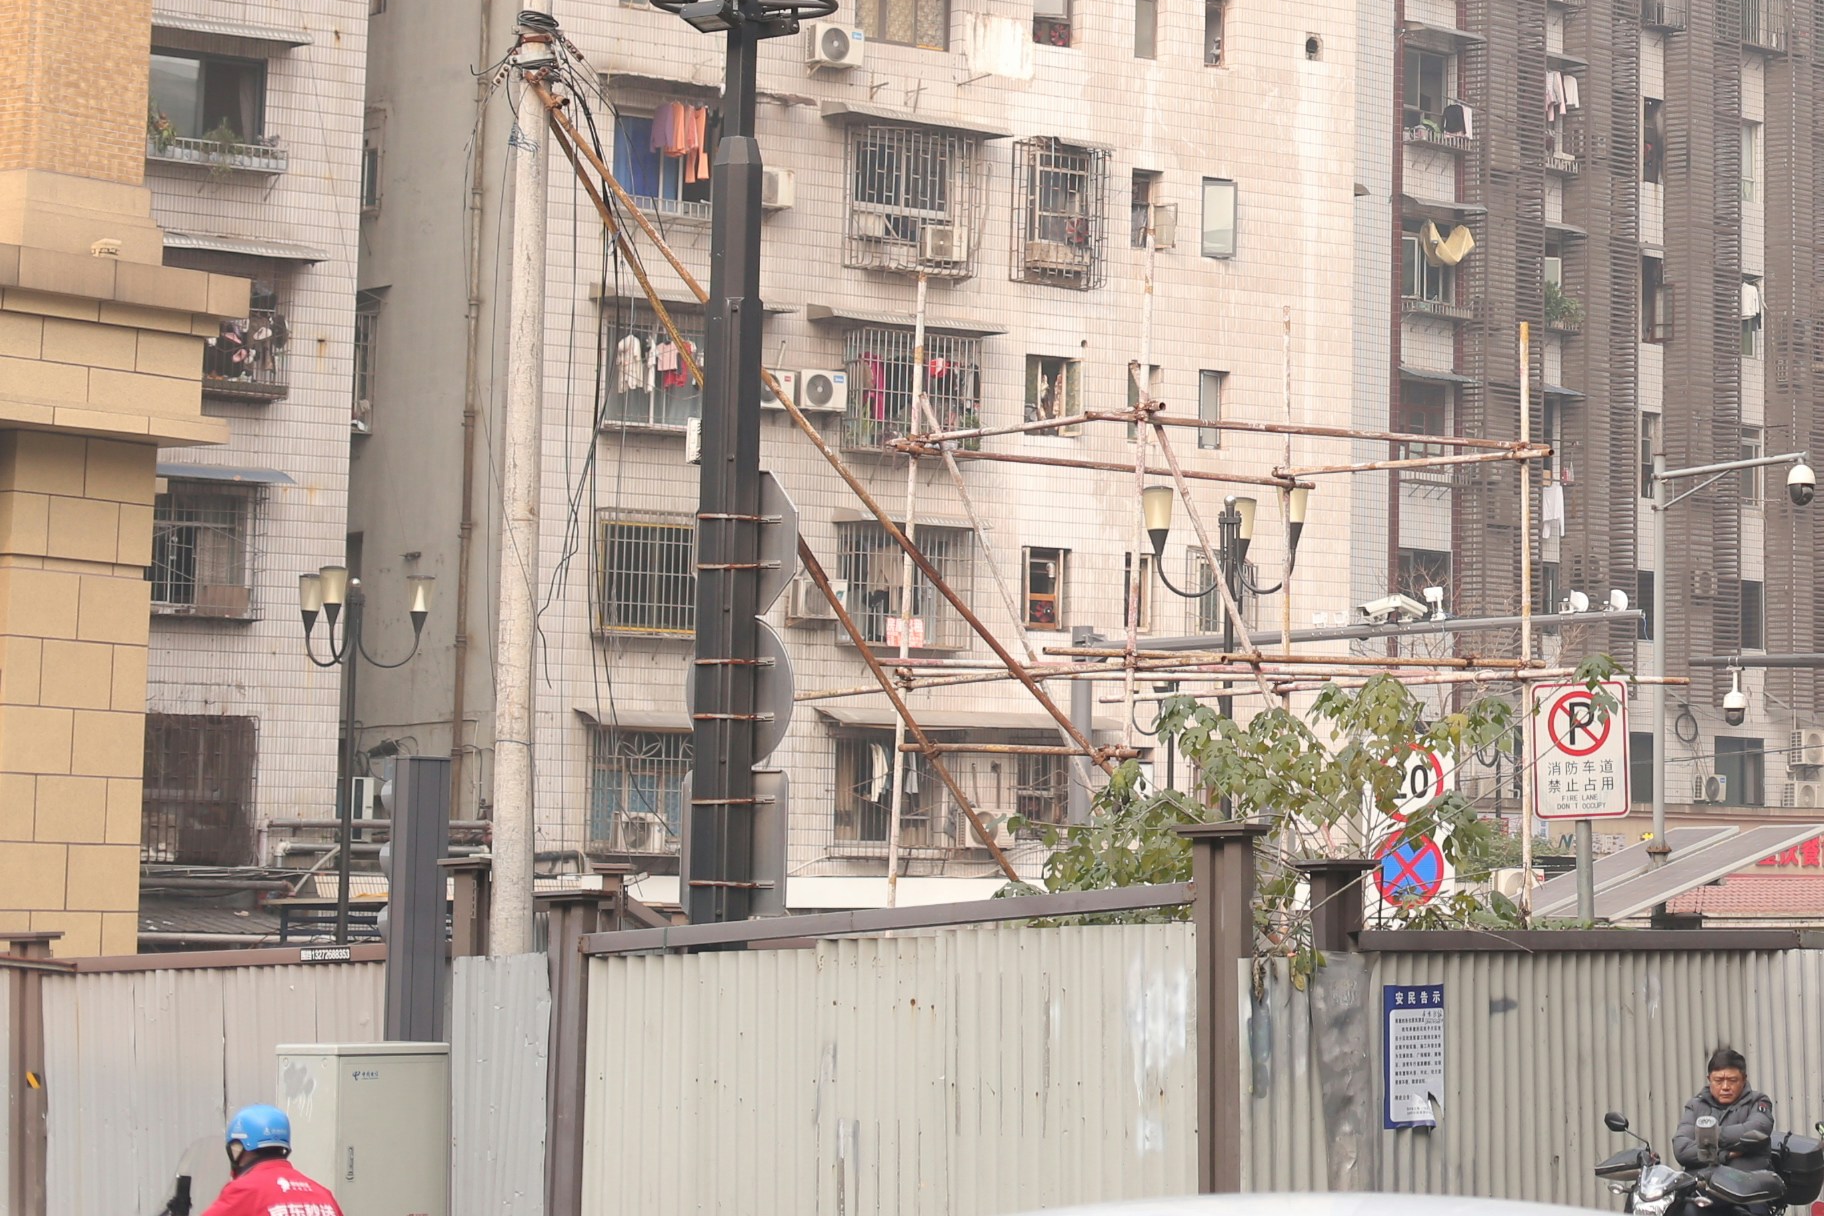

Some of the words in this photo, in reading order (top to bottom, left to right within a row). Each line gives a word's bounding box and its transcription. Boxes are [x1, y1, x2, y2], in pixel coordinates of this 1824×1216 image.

[1547, 759, 1614, 776] 消防车道
[1548, 777, 1614, 793] 禁止占用
[1395, 991, 1441, 1005] 安民告示
